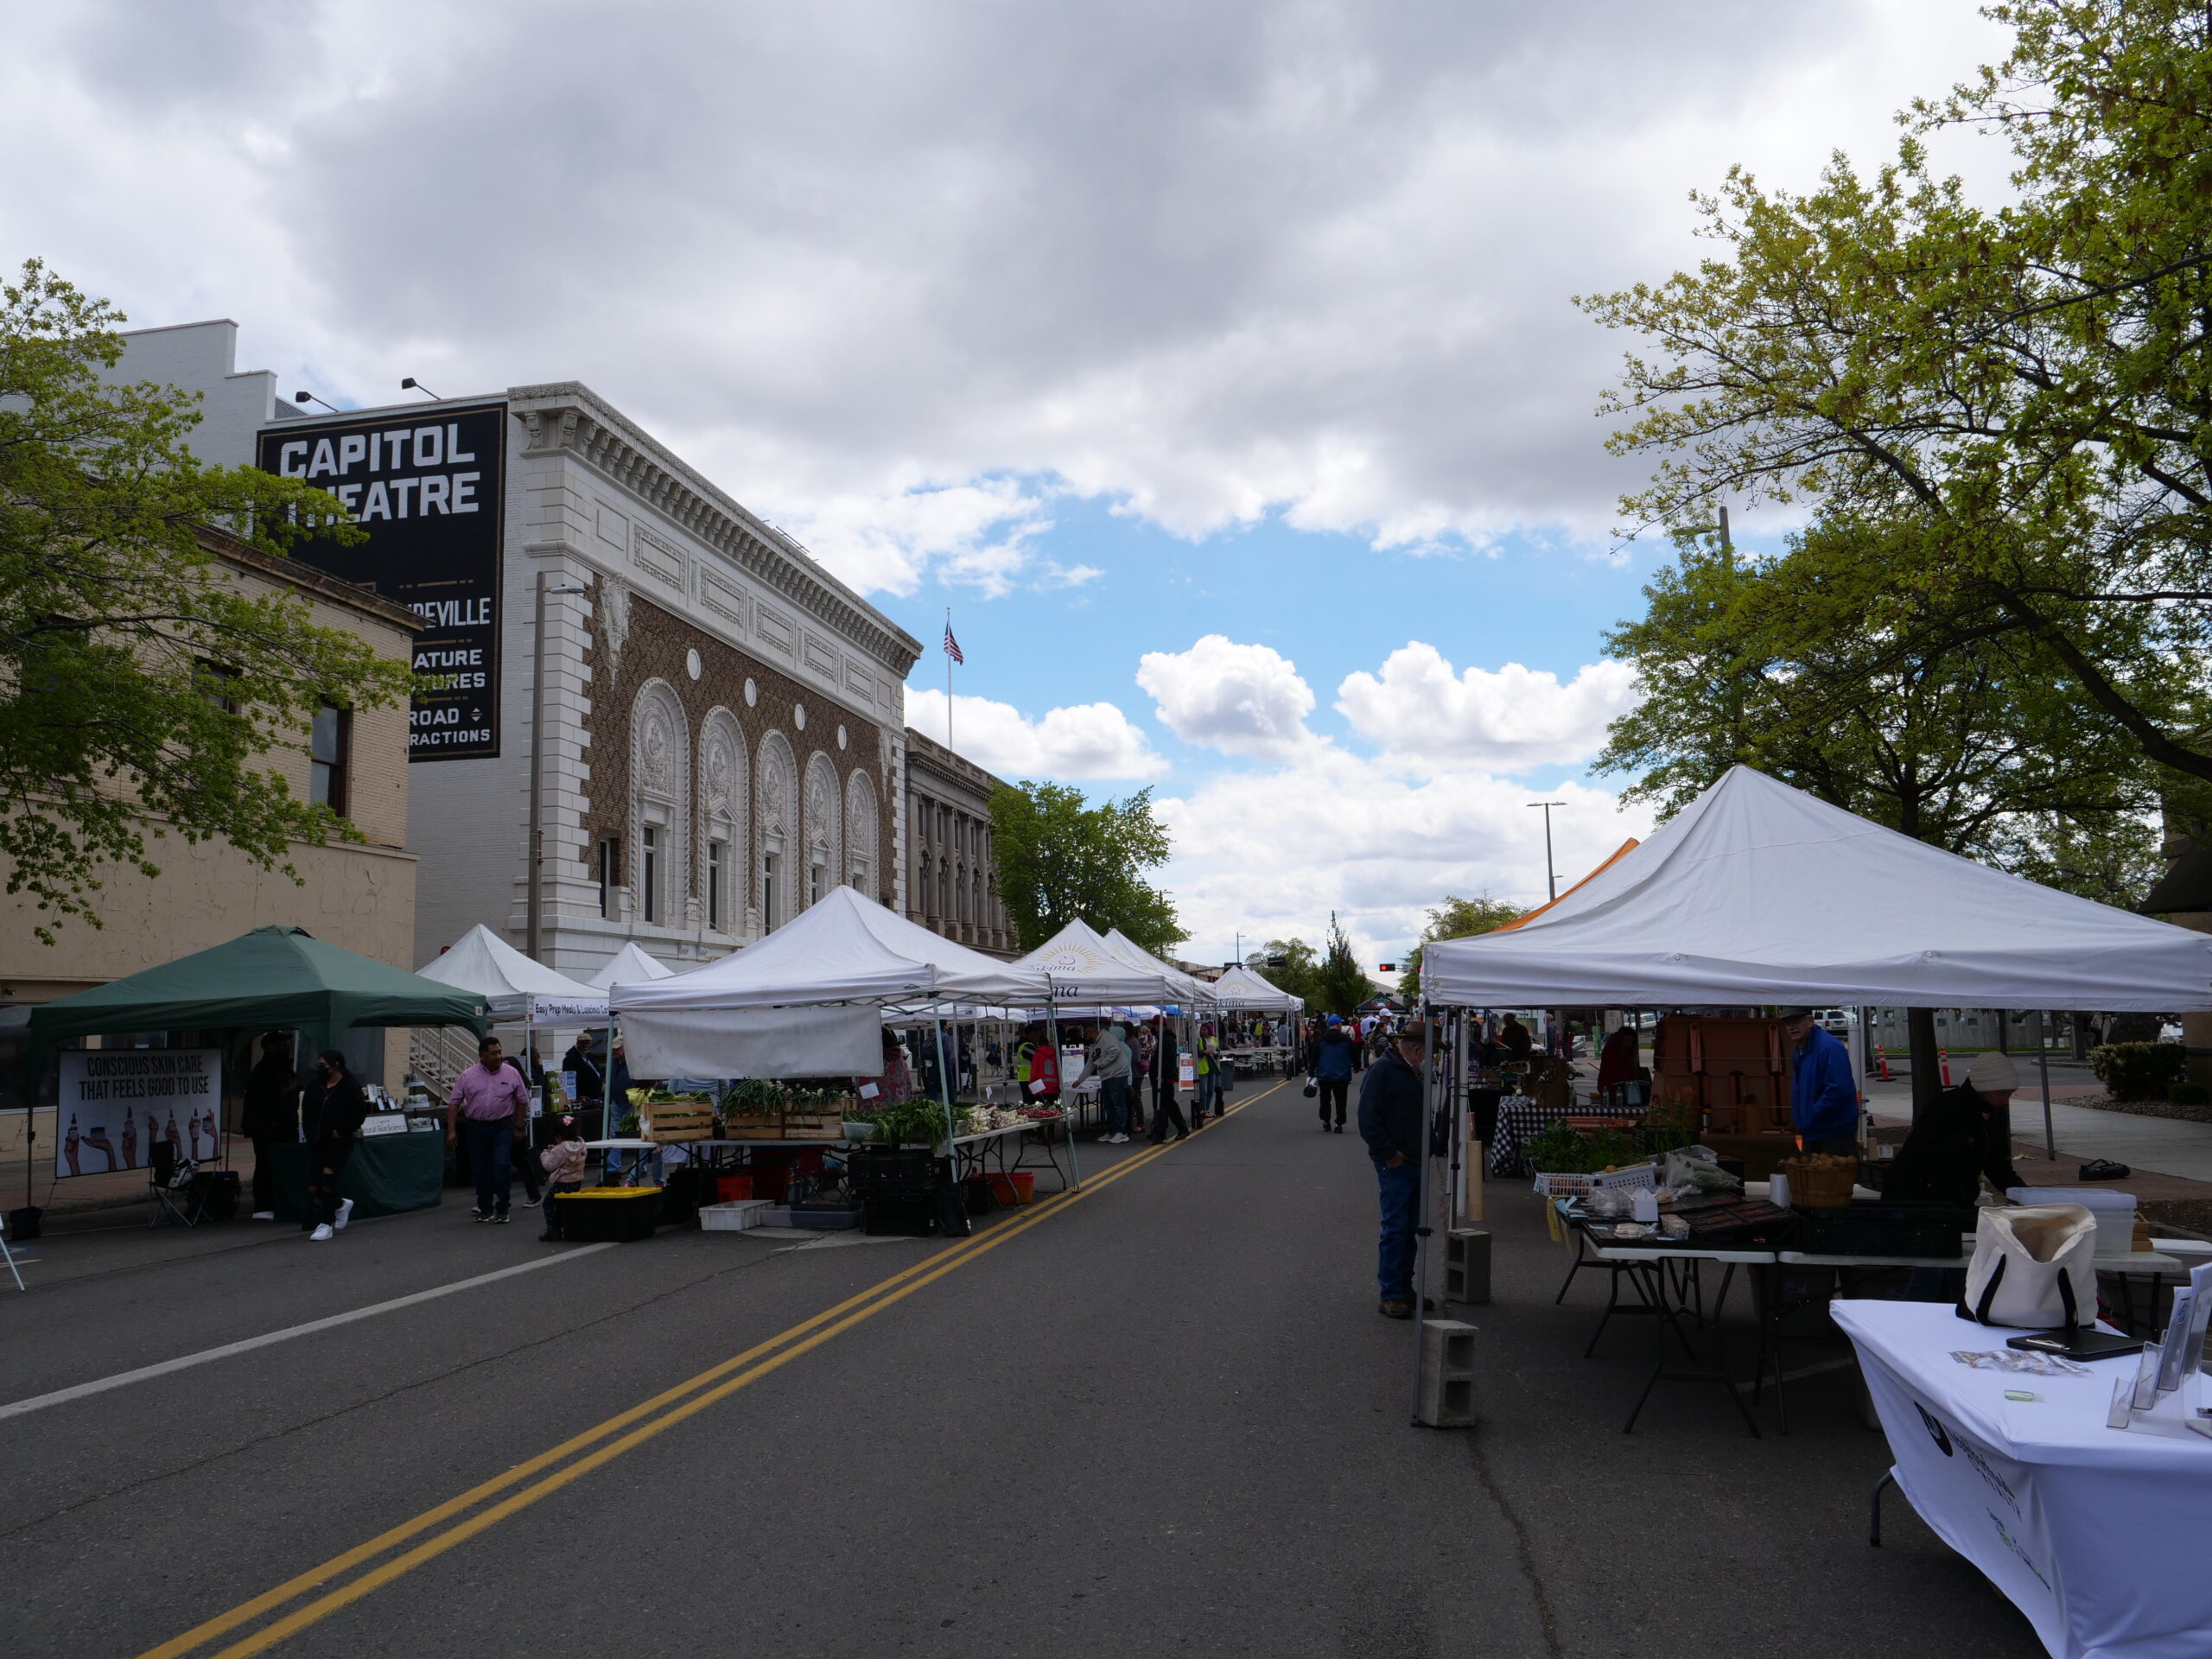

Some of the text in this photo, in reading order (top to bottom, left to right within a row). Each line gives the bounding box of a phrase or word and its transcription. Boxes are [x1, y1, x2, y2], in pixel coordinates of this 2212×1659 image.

[280, 423, 475, 479] CAPITOL
[536, 1004, 548, 1016] Easy
[549, 1003, 562, 1017] Prep
[562, 1004, 576, 1014] Meals
[87, 1055, 203, 1077] CONSCIOUS SKIN CARE
[79, 1076, 209, 1100] THAT FEELS GOOD TO USE
[377, 1123, 388, 1133] Skin
